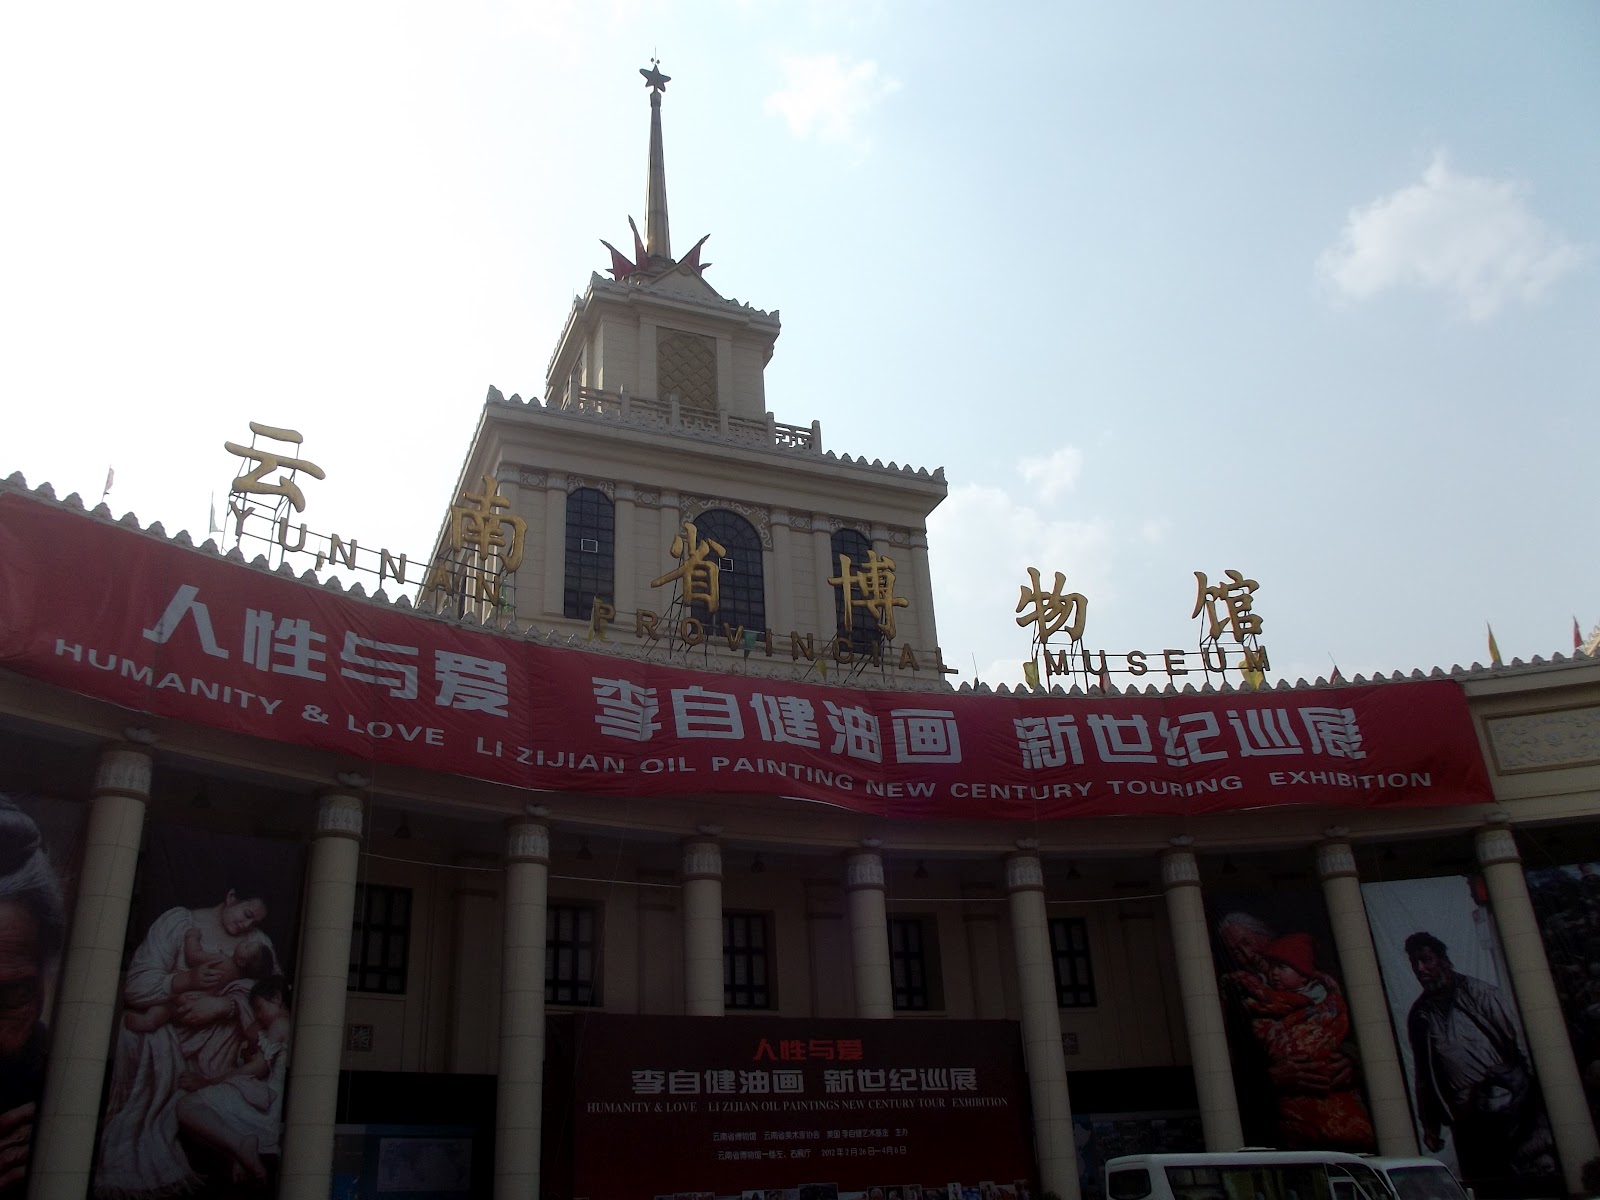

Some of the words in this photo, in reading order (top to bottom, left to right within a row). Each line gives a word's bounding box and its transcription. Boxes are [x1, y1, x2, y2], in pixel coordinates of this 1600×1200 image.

[229, 500, 500, 608] YUNNAN
[593, 603, 958, 674] PROVINCIAL
[1045, 645, 1271, 677] MUSEUM
[142, 584, 509, 718] 人性与爱
[592, 676, 962, 765] 李自健油画
[1012, 706, 1367, 770] 新世纪巡展
[55, 638, 283, 715] HUMANITY
[301, 703, 330, 726] &
[347, 713, 445, 747] LOVE
[476, 736, 502, 758] LI
[516, 745, 626, 775] ZIJIAN
[639, 756, 696, 774] OIL
[712, 755, 854, 792] PAINTING
[865, 779, 936, 799] NEW
[950, 780, 1093, 800] CENTURY
[1106, 775, 1243, 797] TOURING
[1269, 770, 1432, 789] EXHIBITION
[752, 1038, 864, 1062] 人性与爱
[631, 1069, 805, 1095] 李自健油画
[823, 1067, 978, 1094] 新世纪巡展
[587, 1101, 651, 1113] HUMANITY
[654, 1102, 662, 1112] &
[666, 1101, 698, 1112] LOVE
[708, 1101, 719, 1112] LI
[722, 1101, 759, 1112] ZIJIAN
[761, 1101, 780, 1111] OIL
[783, 1100, 840, 1111] PAINTINGS
[842, 1099, 865, 1110] NEW
[868, 1098, 916, 1110] CENTURY
[918, 1098, 946, 1109] TOUR
[952, 1096, 1008, 1108] EXHIBITION
[712, 1131, 757, 1142] 云南省博物馆
